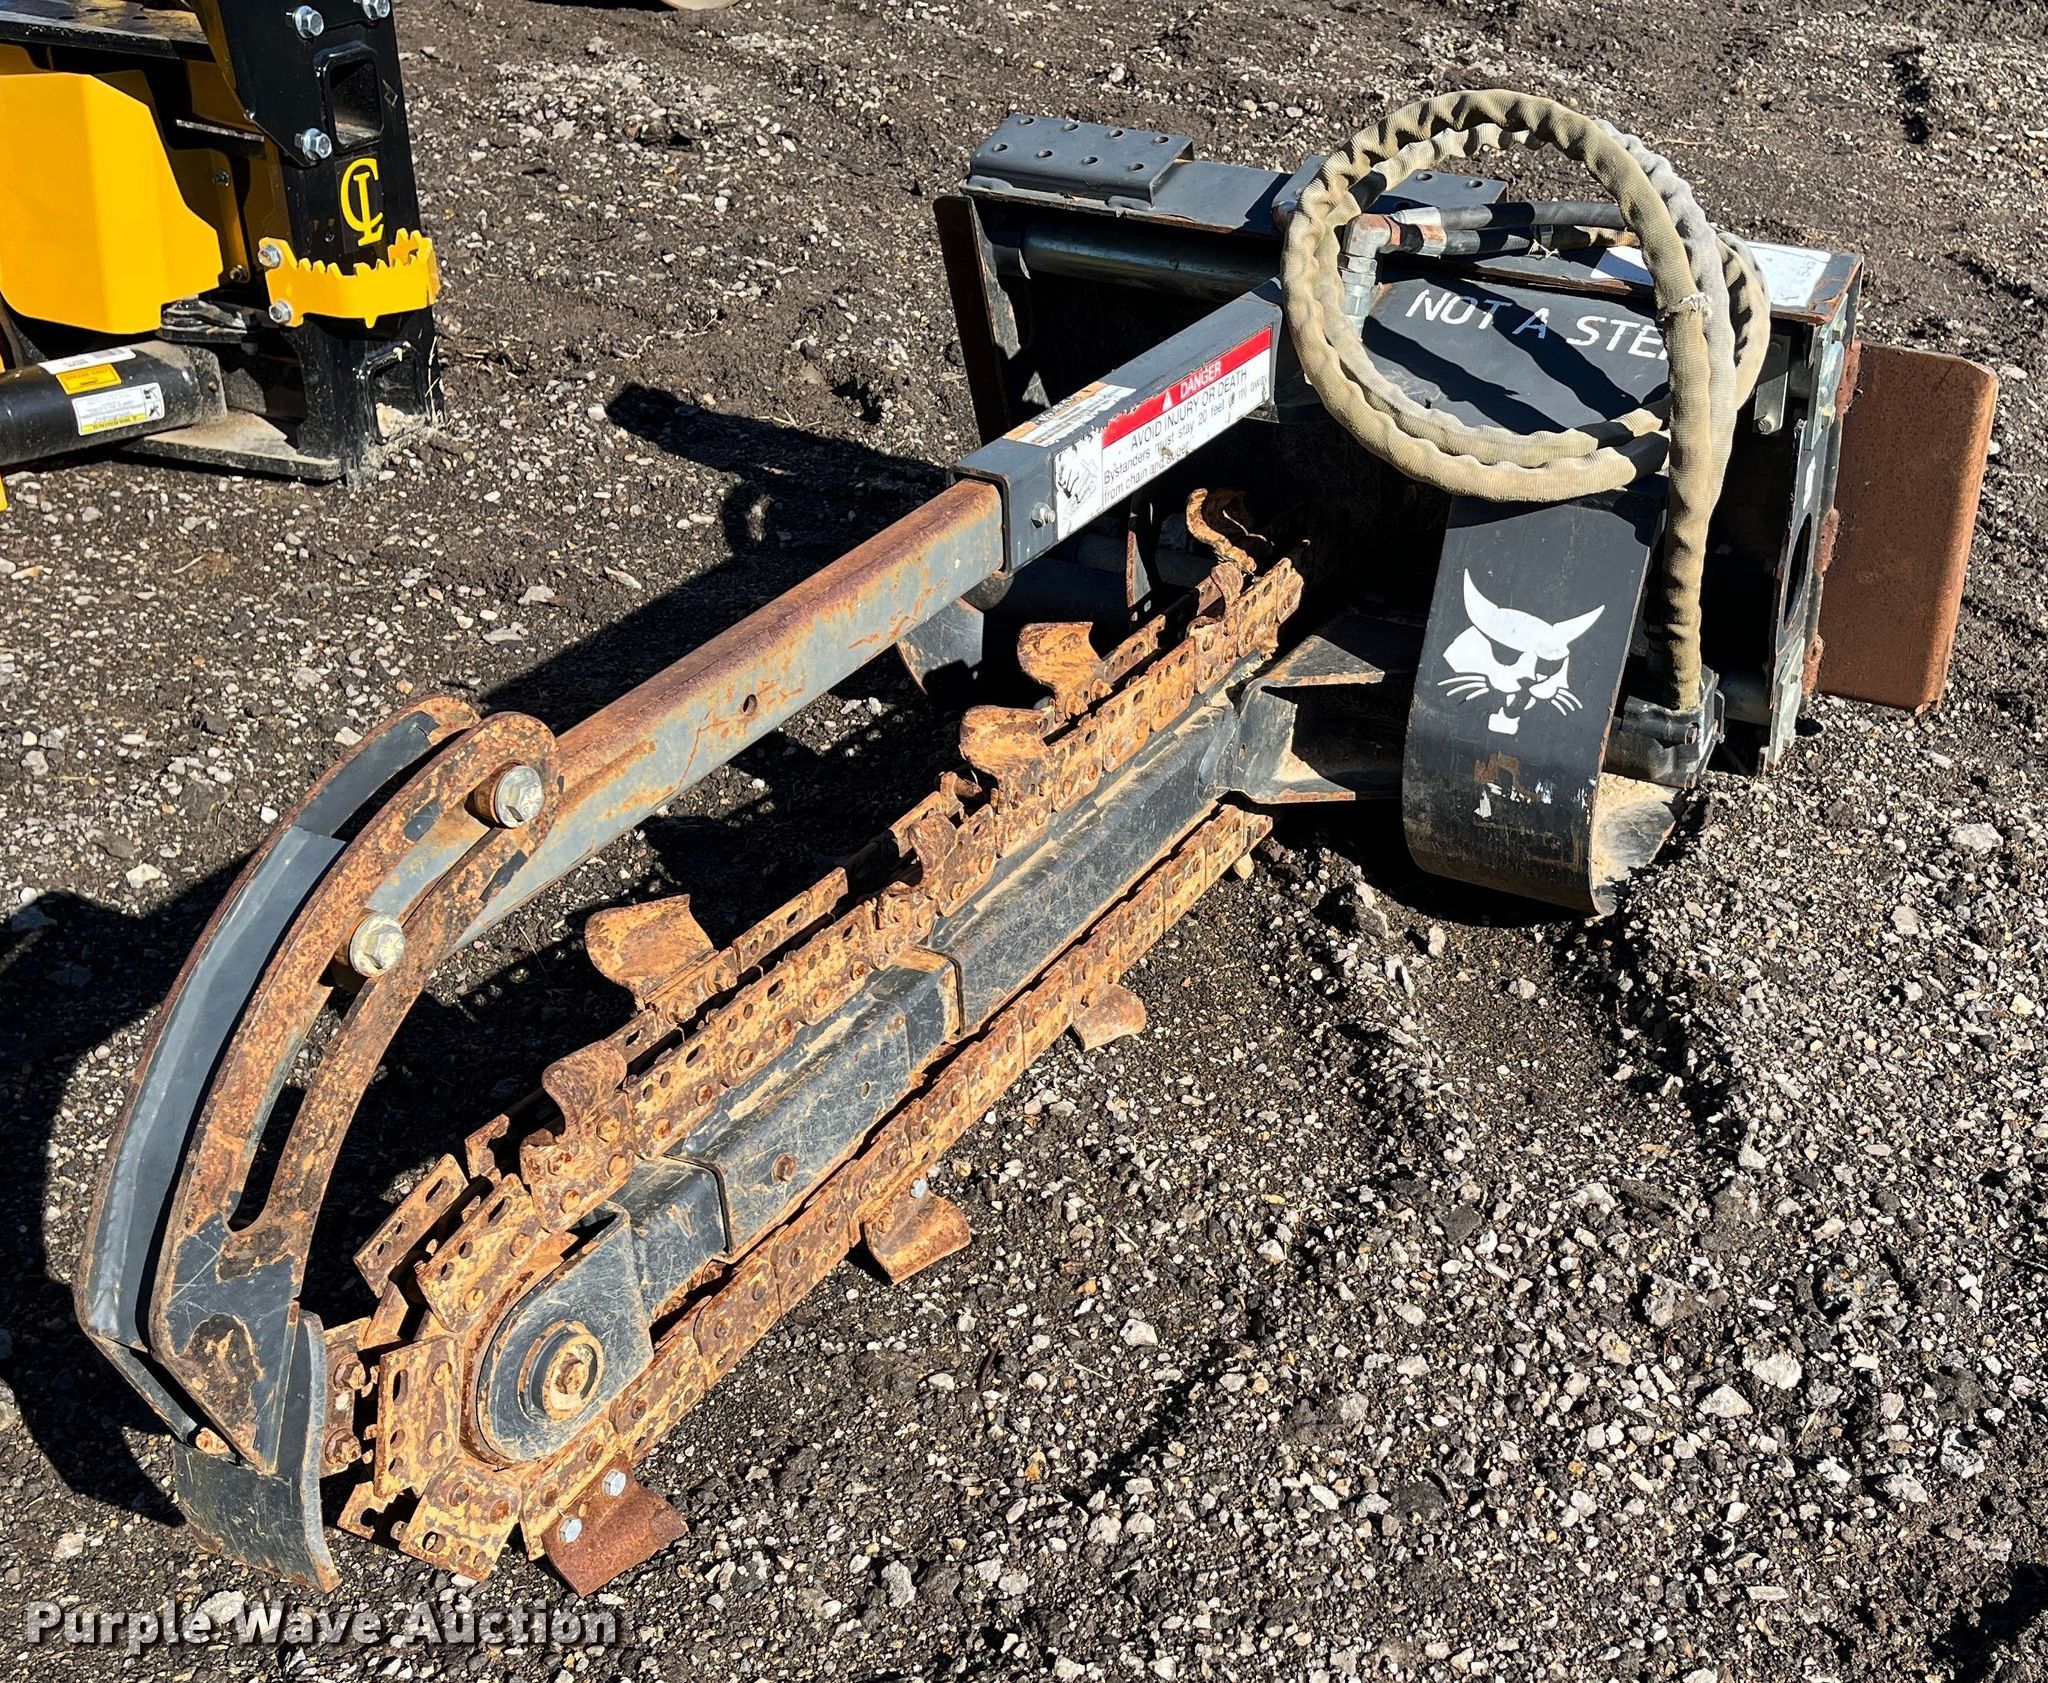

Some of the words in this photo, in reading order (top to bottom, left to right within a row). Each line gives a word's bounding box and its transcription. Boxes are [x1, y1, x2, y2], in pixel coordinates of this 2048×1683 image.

[1405, 289, 1512, 330] NOT
[1512, 307, 1550, 339] A
[1566, 316, 1668, 360] STE
[1131, 420, 1162, 451] AVOID
[1164, 398, 1199, 430] INJURY
[1202, 386, 1216, 407] OR
[1218, 367, 1248, 398] DEATH
[1180, 360, 1222, 399] DANGER
[1103, 448, 1150, 486] Bystanders
[1178, 420, 1195, 439] stay
[1198, 409, 1208, 426] 20
[1251, 374, 1267, 392] away
[1104, 484, 1124, 503] from
[1126, 468, 1143, 490] chain
[1149, 456, 1165, 476] and
